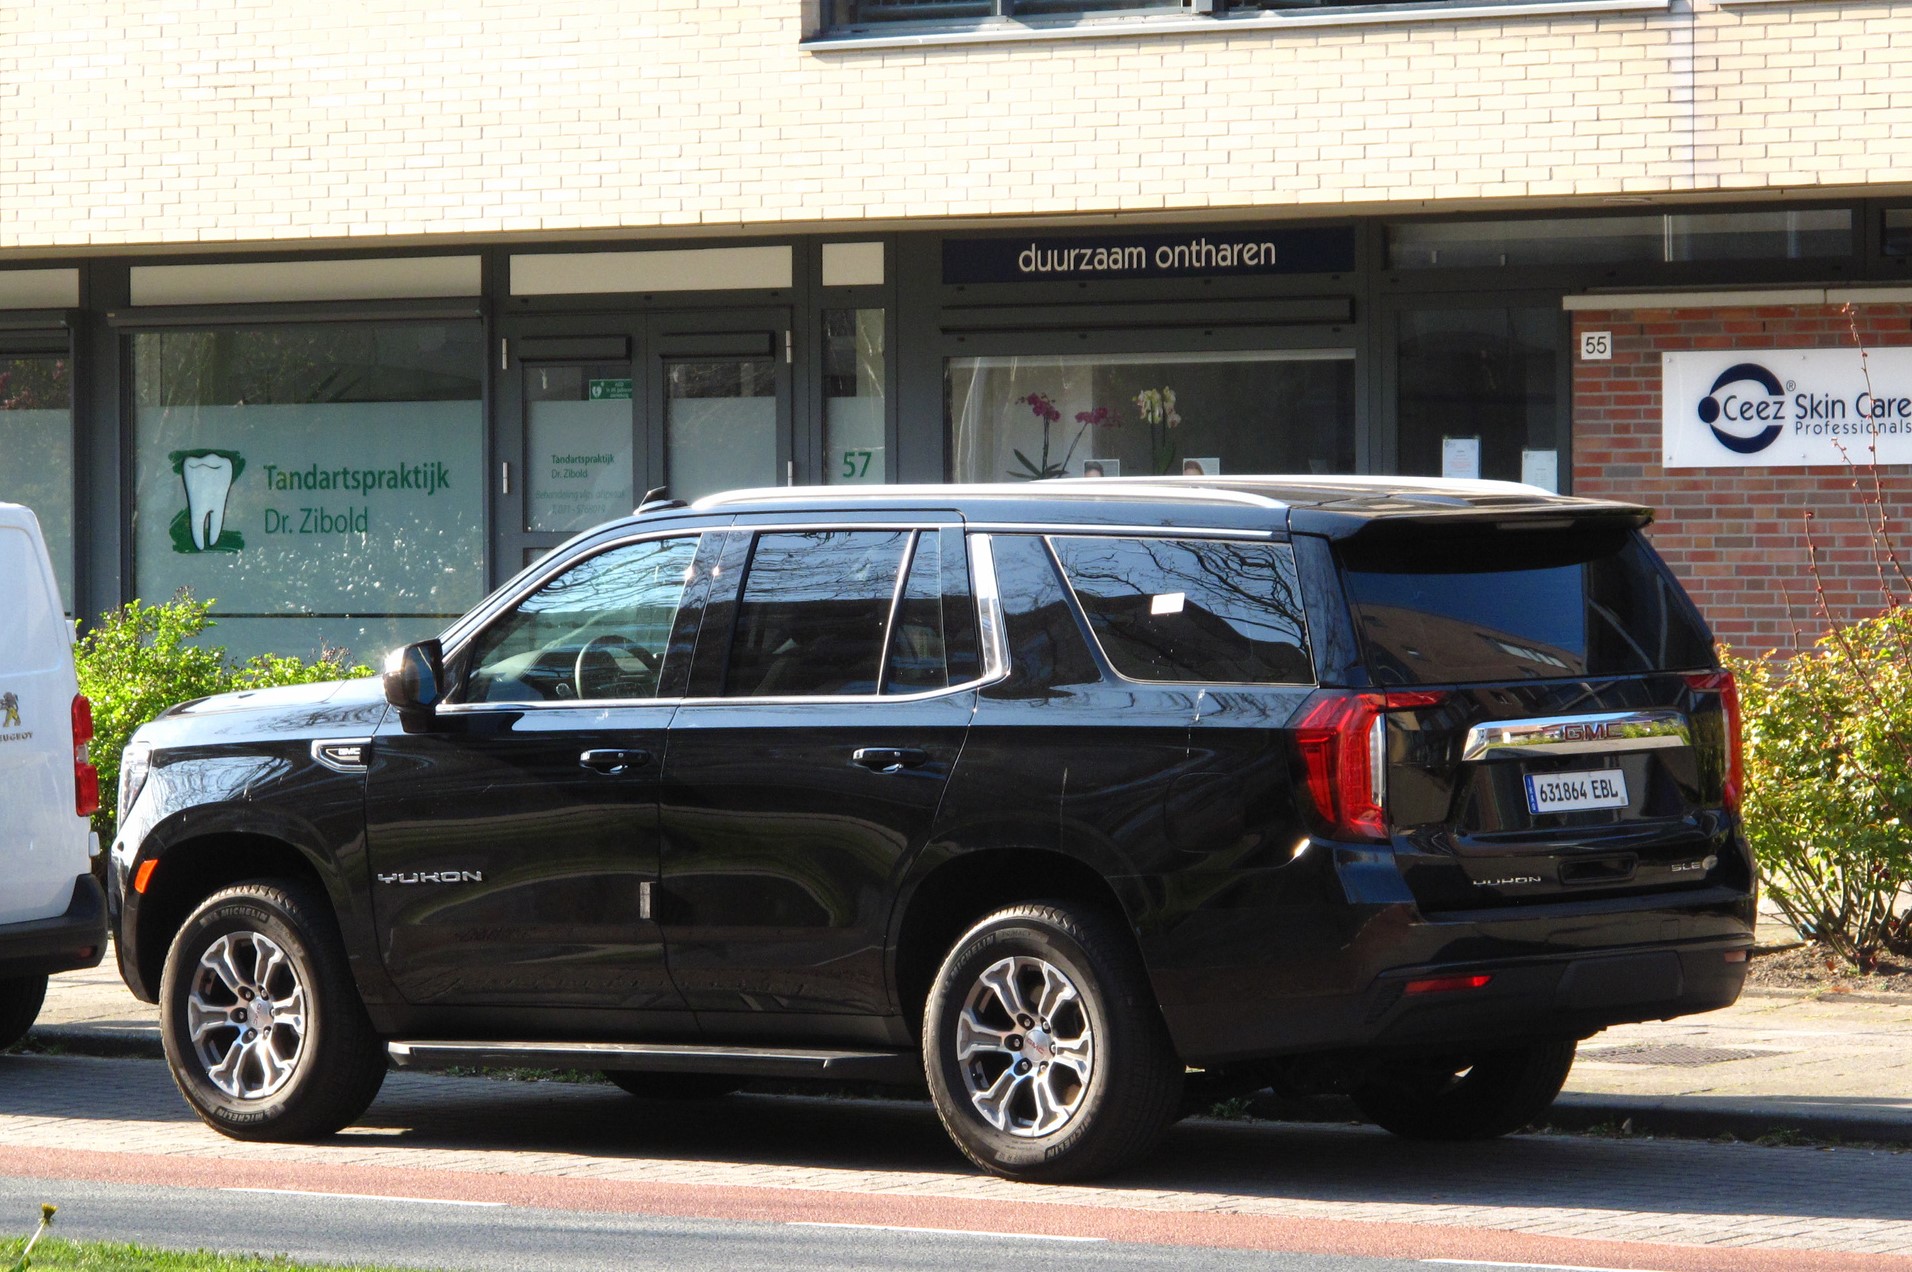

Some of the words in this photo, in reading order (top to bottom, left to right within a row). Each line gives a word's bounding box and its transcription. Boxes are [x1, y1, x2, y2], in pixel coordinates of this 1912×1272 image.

[1018, 243, 1146, 272] duurzaam
[1155, 238, 1276, 268] ontharen
[1585, 336, 1607, 354] 55
[1723, 394, 1786, 421] Ceez
[1795, 393, 1846, 420] Skin
[1855, 392, 1912, 419] Care
[1795, 419, 1912, 435] Professionals
[551, 453, 615, 466] Tandartspraktijk
[843, 452, 872, 478] 57
[263, 462, 450, 496] Tandartspraktijk
[551, 469, 562, 479] Dr.
[563, 468, 588, 479] Zibold
[264, 508, 293, 534] Dr.
[300, 506, 368, 534] Zibold
[1563, 723, 1622, 741] GMC
[338, 747, 361, 756] GMC
[1539, 780, 1588, 803] 631864
[1591, 778, 1619, 799] EBL
[377, 870, 483, 884] YUKON
[221, 906, 268, 921] MICHELIN
[950, 934, 995, 979] MICHELIN
[215, 1106, 264, 1123] MICHELIN
[1046, 1113, 1092, 1159] MICHELIN
